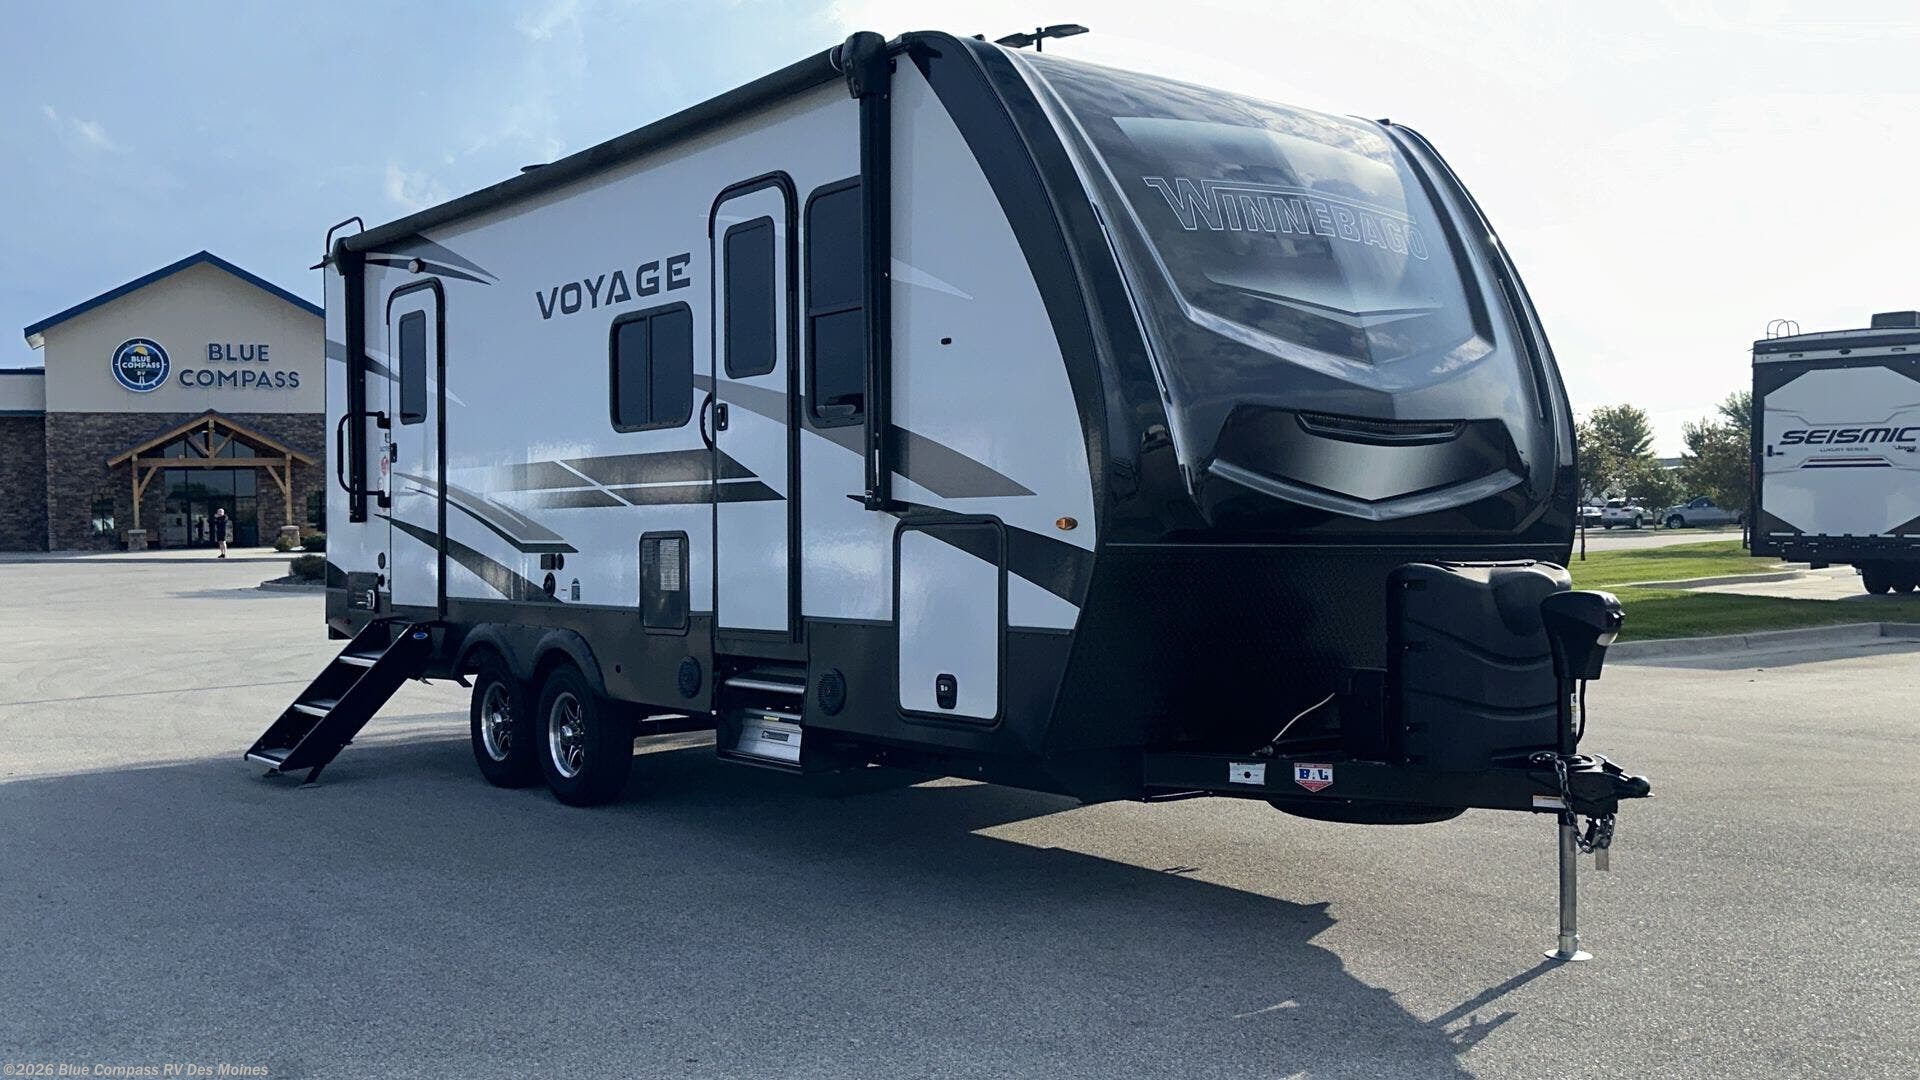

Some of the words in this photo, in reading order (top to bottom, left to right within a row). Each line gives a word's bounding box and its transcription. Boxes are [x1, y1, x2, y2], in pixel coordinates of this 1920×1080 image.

[1142, 177, 1430, 260] WINNEBAGO
[536, 252, 691, 319] VOYAGE
[208, 343, 270, 362] BLUE
[122, 361, 160, 369] COMPASS
[180, 369, 300, 388] COMPASS
[1779, 427, 1920, 445] SEISMIC
